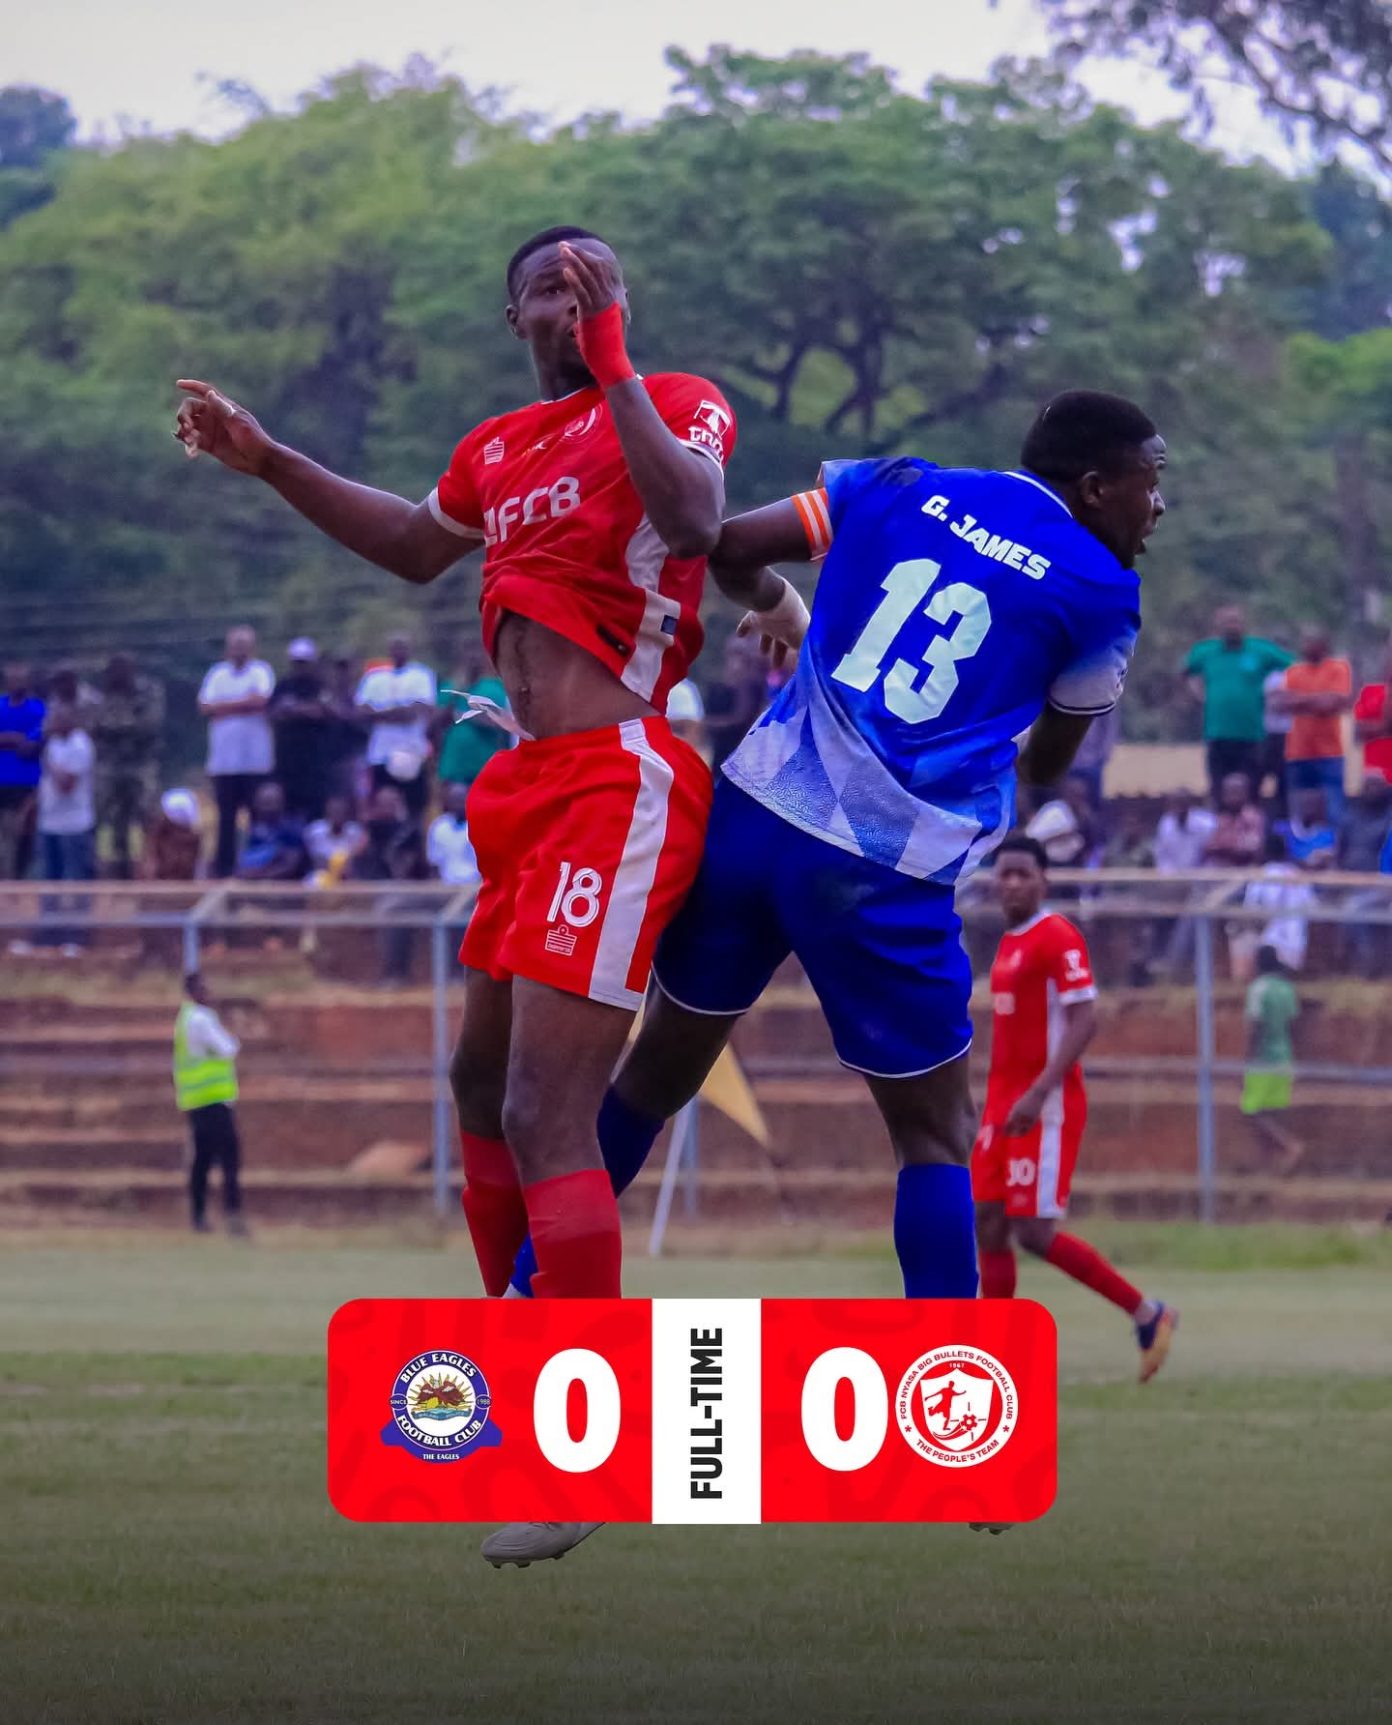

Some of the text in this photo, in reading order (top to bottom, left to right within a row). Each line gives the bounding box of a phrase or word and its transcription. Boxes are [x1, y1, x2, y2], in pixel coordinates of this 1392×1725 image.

[920, 495, 1051, 580] G. JAMES
[830, 557, 992, 725] 13
[546, 861, 603, 928] 18
